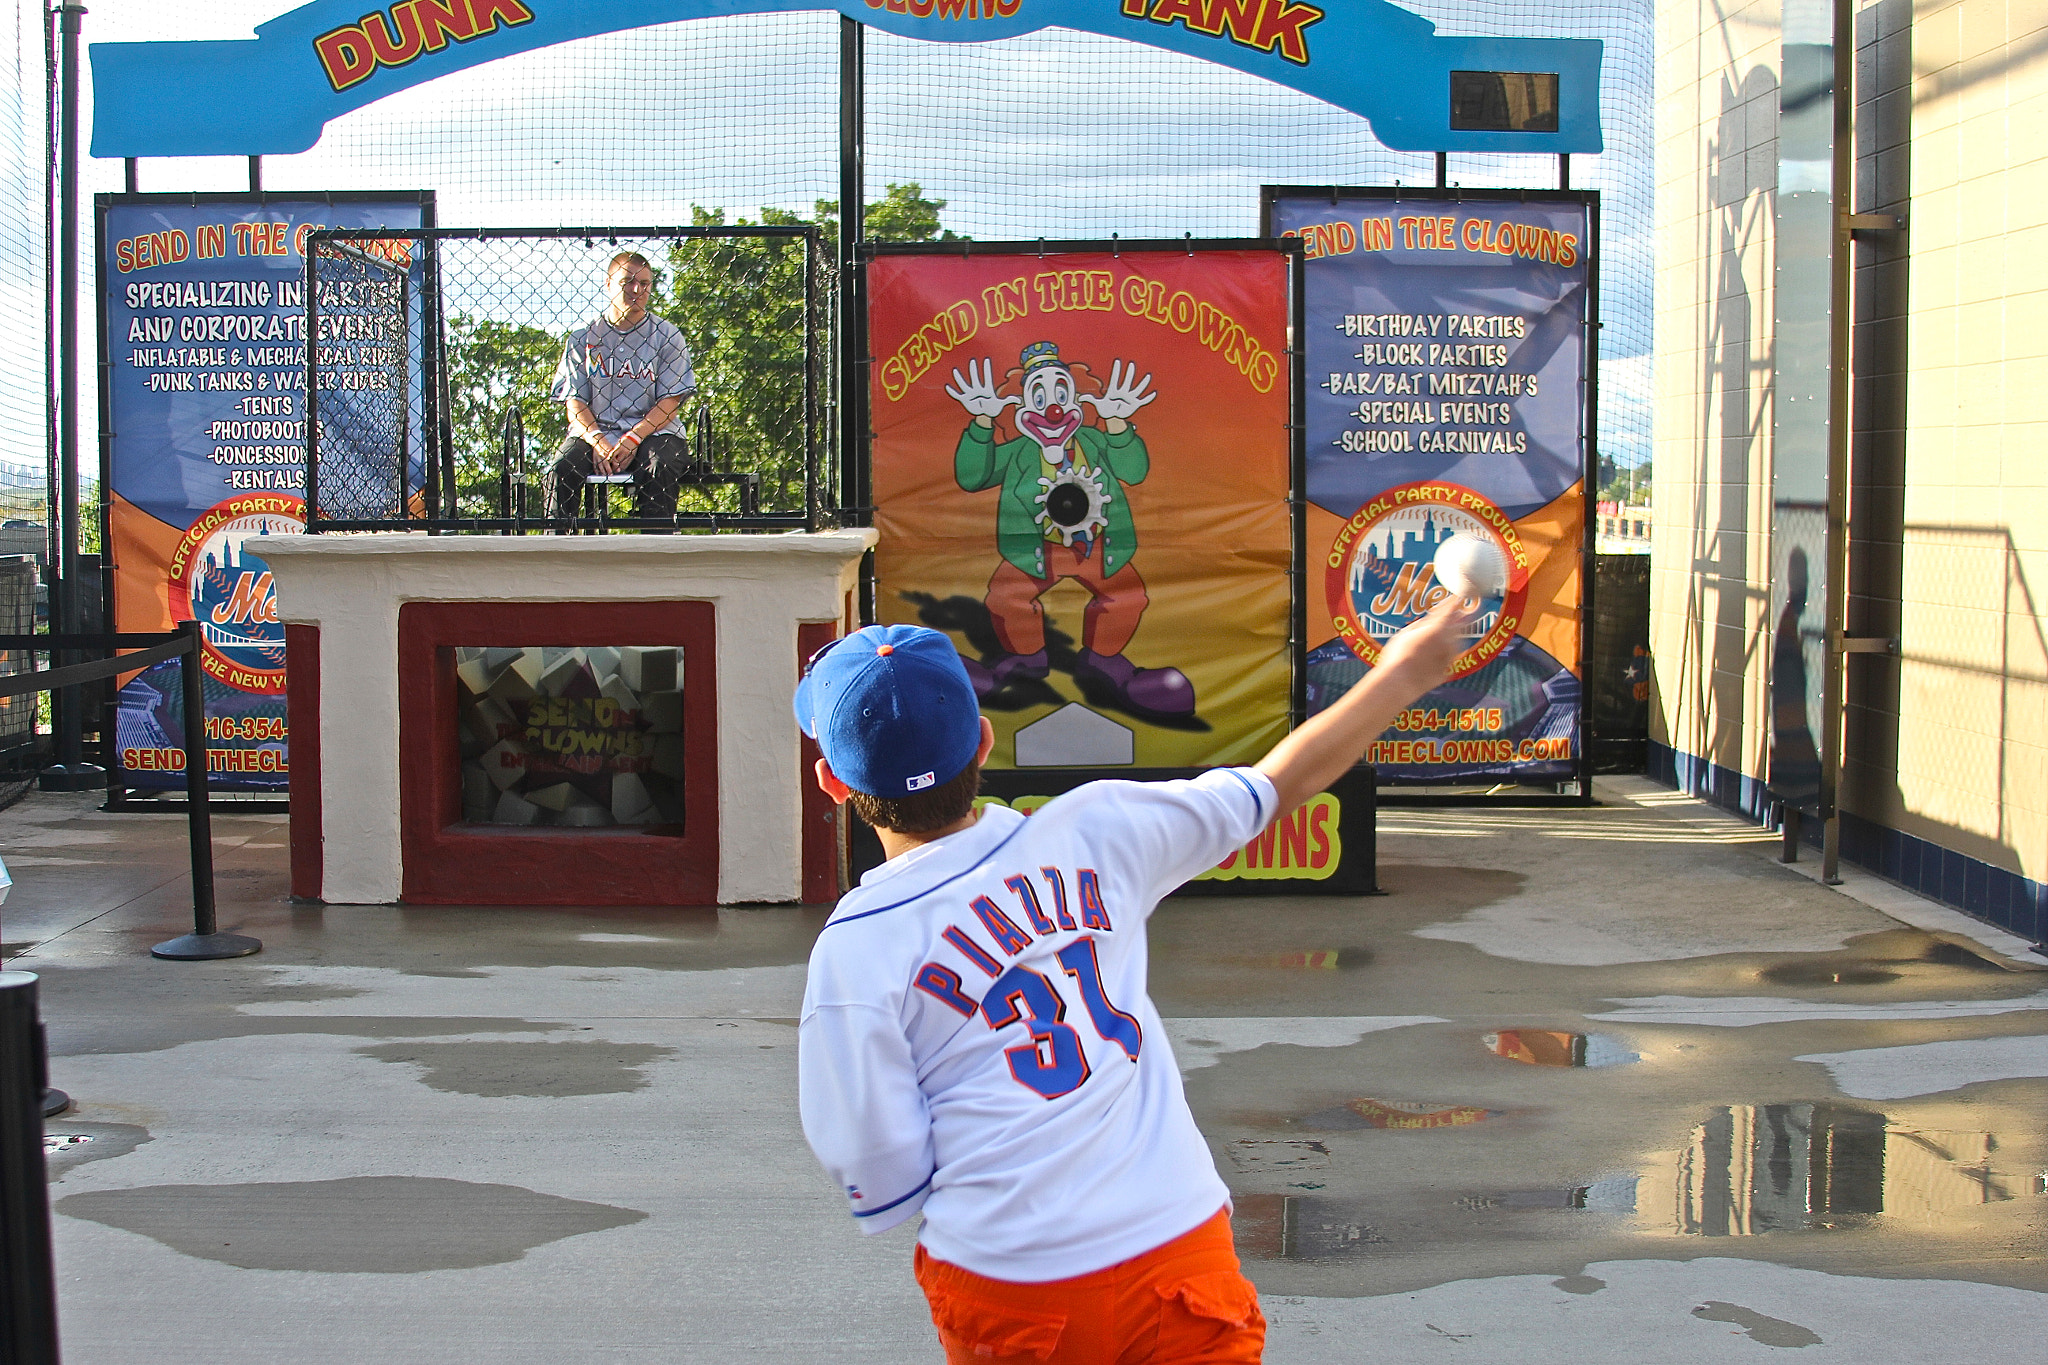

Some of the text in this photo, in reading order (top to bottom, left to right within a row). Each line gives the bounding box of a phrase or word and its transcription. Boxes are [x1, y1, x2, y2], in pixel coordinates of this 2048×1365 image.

[1122, 0, 1323, 64] ANK
[116, 229, 190, 274] SEND
[196, 224, 226, 259] IN
[232, 222, 288, 256] THE
[1362, 218, 1392, 251] IN
[1398, 216, 1456, 251] THE
[1462, 219, 1578, 268] CLOWNS
[125, 281, 271, 308] SPECIALIZING
[278, 282, 302, 308] IN
[127, 316, 174, 343] AND
[880, 270, 1278, 402] SEND IN THE CLOWNS
[1335, 315, 1525, 338] -BIRTHDAY PARTIES
[126, 348, 226, 368] -INFLATABLE
[231, 349, 244, 367] &
[248, 348, 355, 368] MECHAICAL
[1354, 344, 1508, 367] -BLOCK PARTIES
[143, 372, 194, 391] -DUNK
[199, 372, 253, 391] TANKS
[258, 372, 270, 390] &
[275, 372, 337, 391] WAER
[1321, 373, 1538, 397] -BAR/BAT MITZVAH'S
[235, 396, 293, 416] -TENTS
[1349, 402, 1510, 425] -SPECIAL EVENTS
[1332, 430, 1526, 453] -SCHOOL CARNIVALS
[224, 470, 306, 489] -RENTALS
[170, 498, 293, 579] OFFICIAL PARTY
[1328, 486, 1527, 570] OFFICIAL PARTY PROVIDER
[1332, 616, 1353, 639] OF
[1478, 615, 1517, 660] METS
[201, 649, 228, 678] THE
[229, 670, 268, 688] NEW
[913, 866, 1113, 1018] PIAZZA
[980, 936, 1142, 1100] 31
